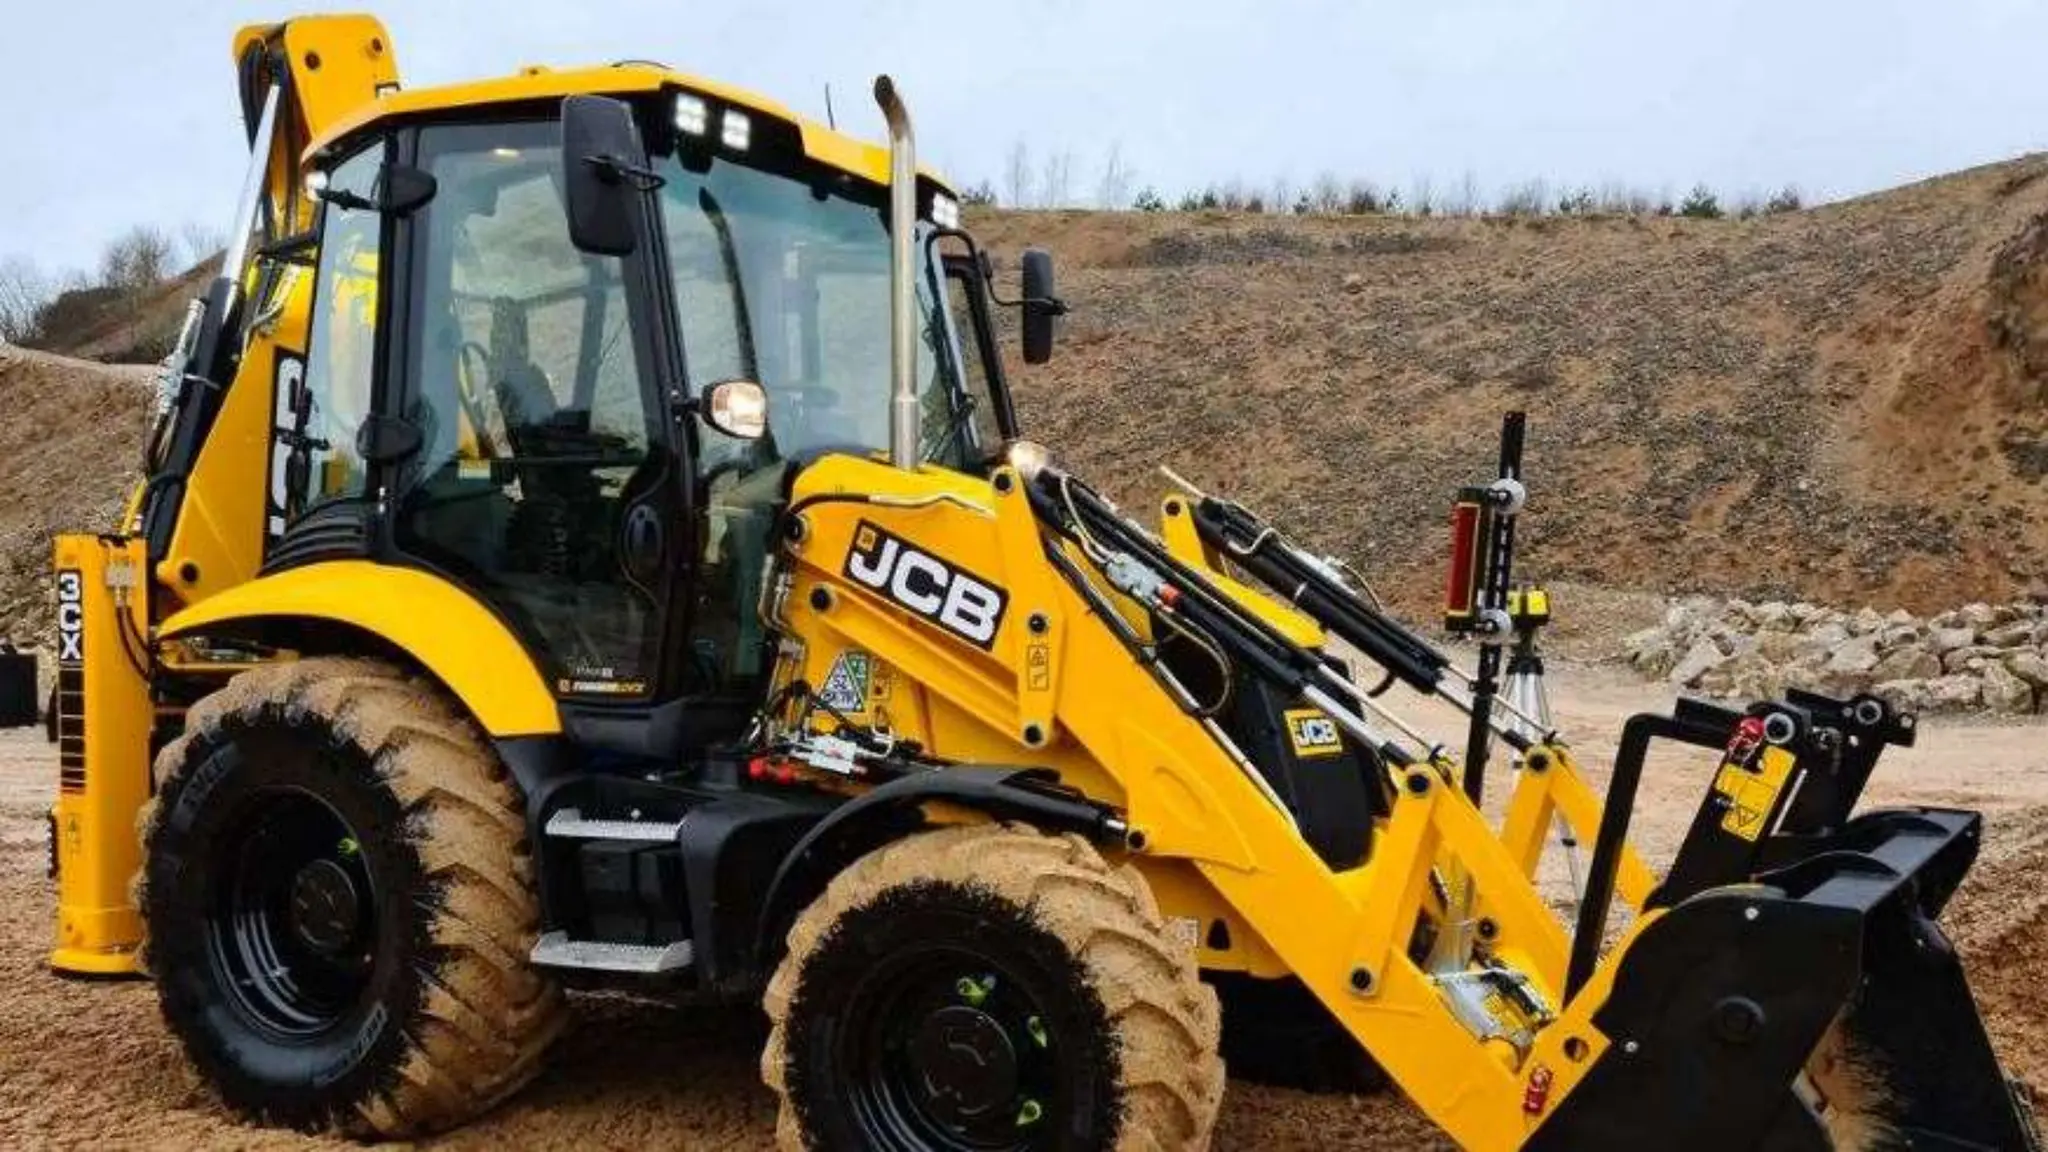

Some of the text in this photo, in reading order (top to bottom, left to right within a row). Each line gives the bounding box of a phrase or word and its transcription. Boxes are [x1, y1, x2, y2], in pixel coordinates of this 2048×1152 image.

[60, 572, 81, 660] 3CX
[850, 538, 1001, 642] JCB
[1297, 718, 1338, 746] JCB
